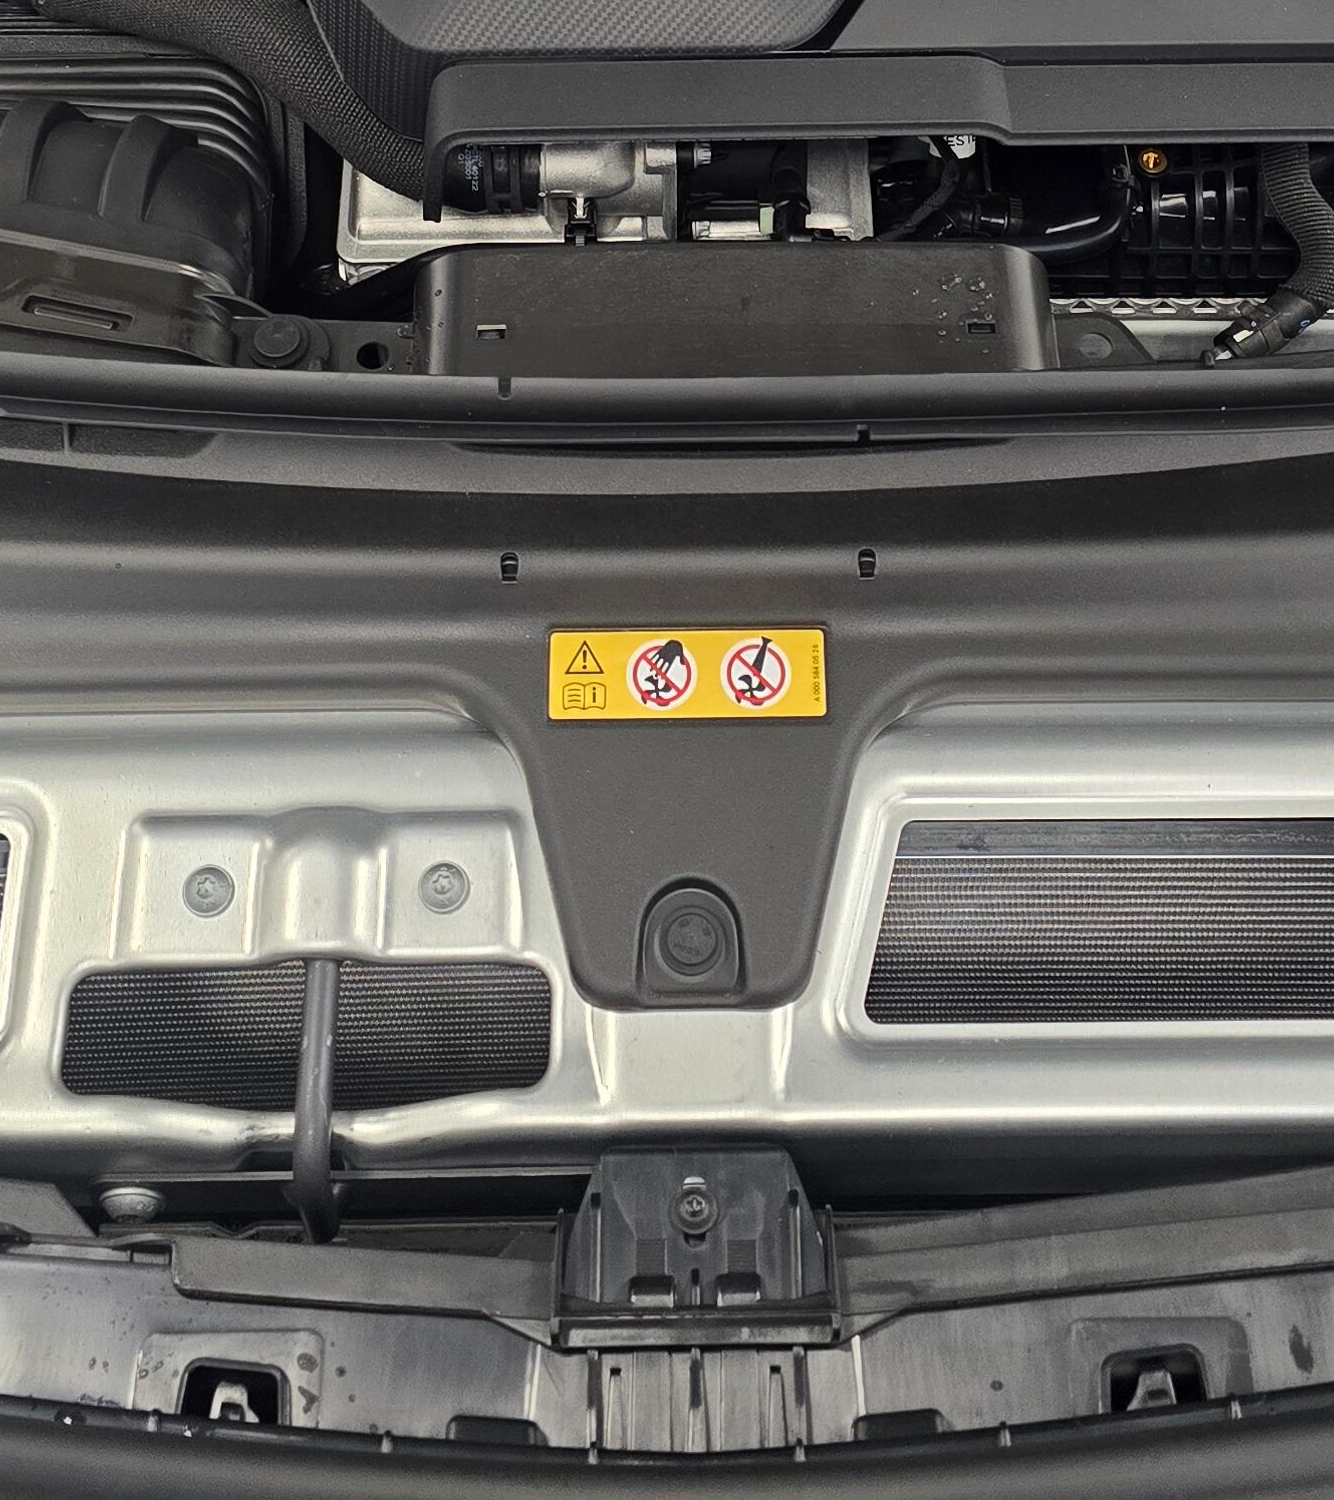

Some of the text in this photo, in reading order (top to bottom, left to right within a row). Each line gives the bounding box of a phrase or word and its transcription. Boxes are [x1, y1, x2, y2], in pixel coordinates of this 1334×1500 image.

[811, 666, 820, 680] 584
[812, 681, 821, 696] 000
[812, 695, 821, 703] A
